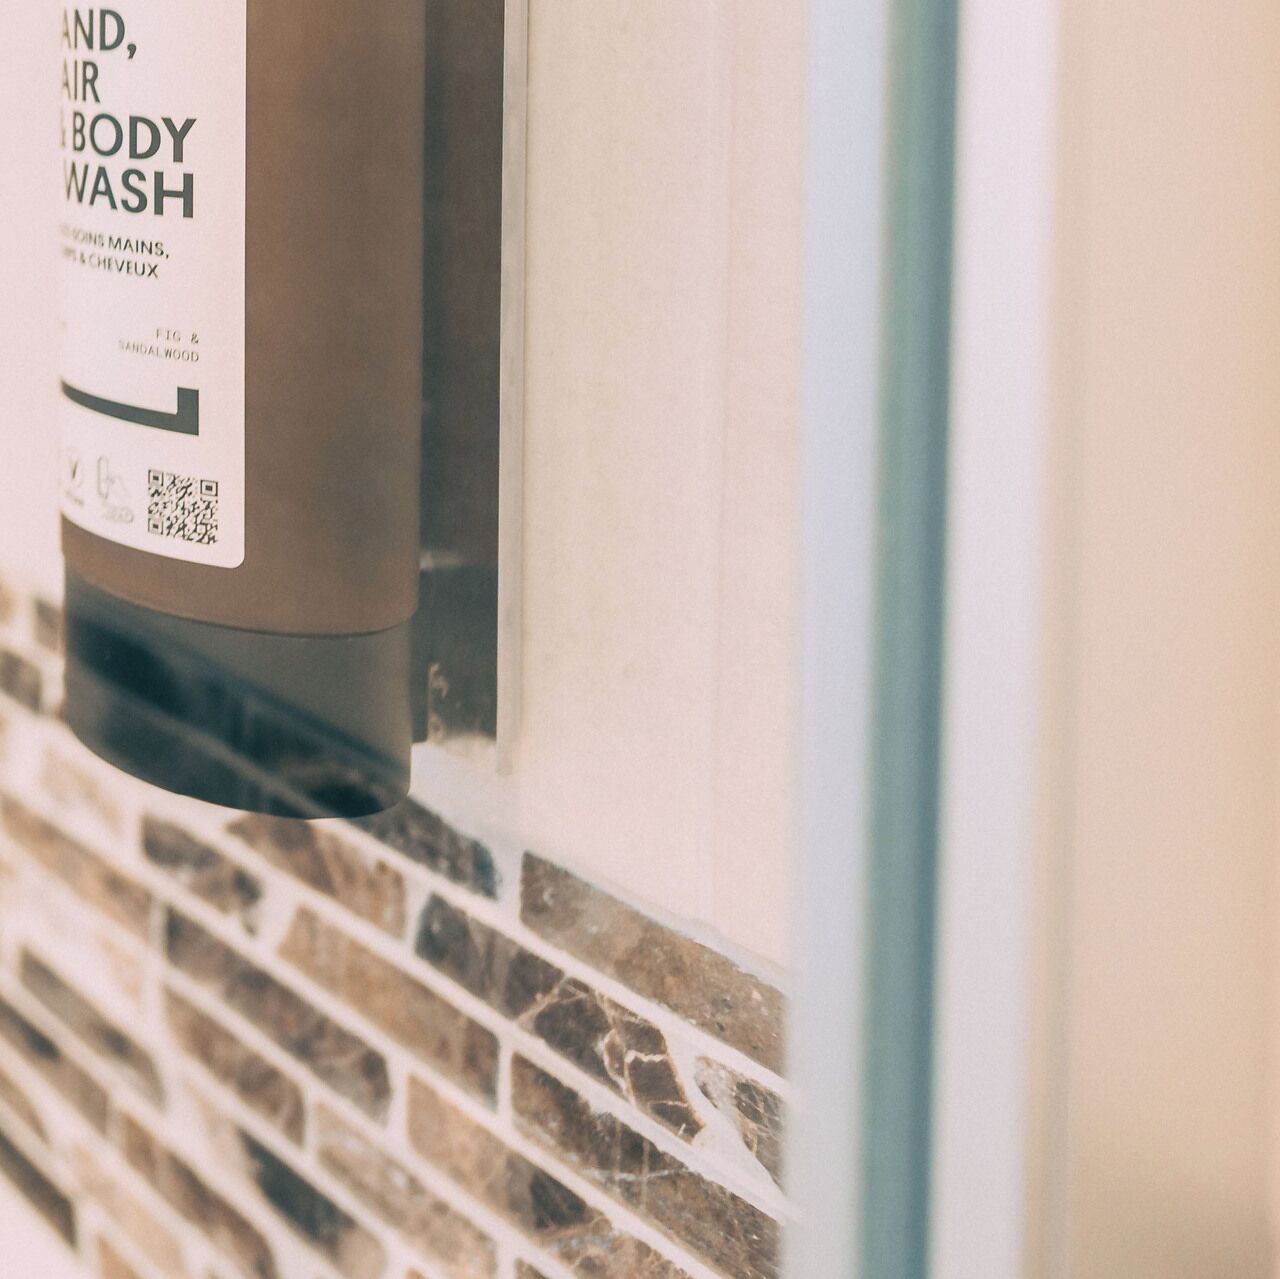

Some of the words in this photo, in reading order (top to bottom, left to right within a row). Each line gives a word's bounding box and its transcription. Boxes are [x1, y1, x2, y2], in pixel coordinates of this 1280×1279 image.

[72, 110, 197, 164] BODY
[63, 158, 195, 219] WASH
[108, 235, 169, 260] MAINS,
[88, 253, 160, 279] CHEVEUX
[155, 327, 182, 342] FIG
[190, 333, 200, 344] &
[117, 338, 200, 363] SANDALWOOD
